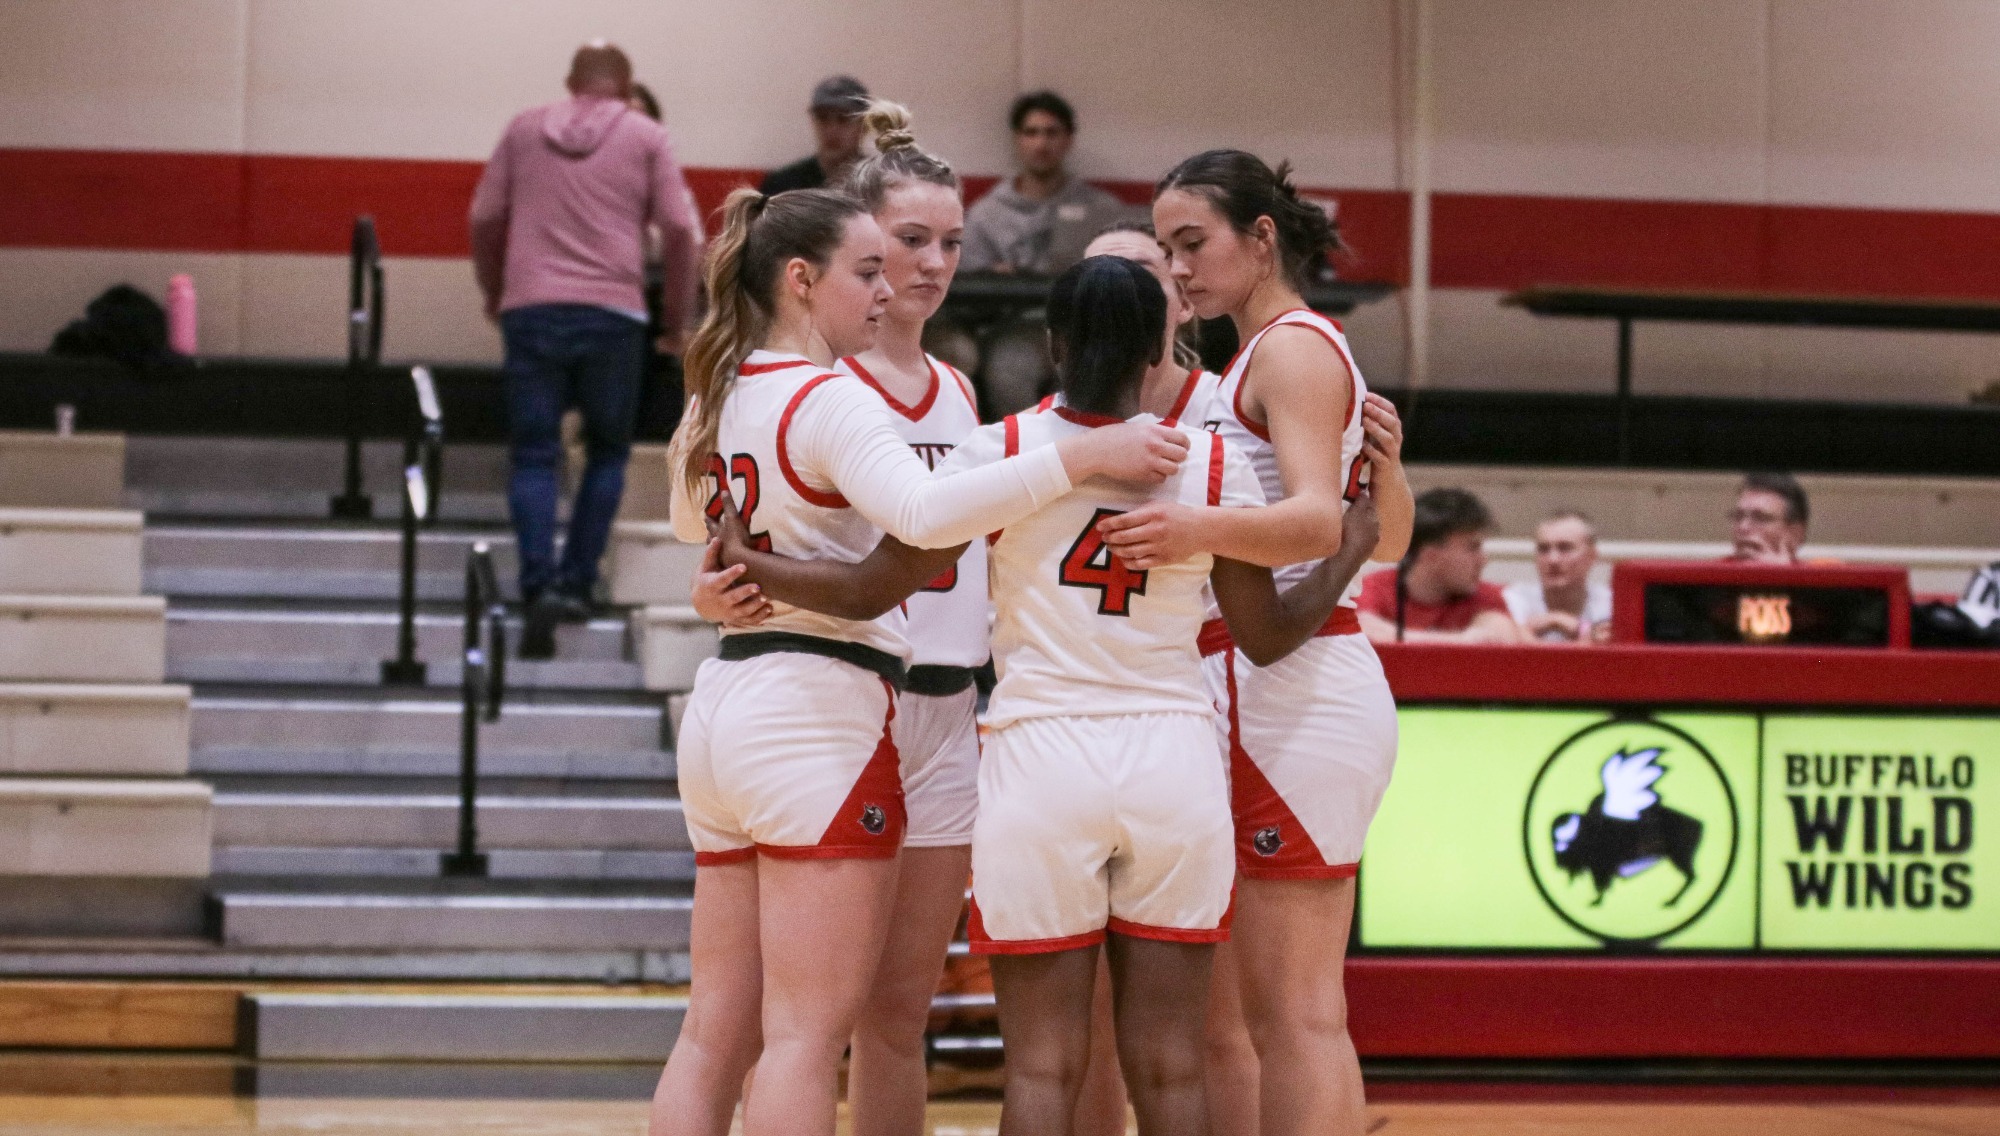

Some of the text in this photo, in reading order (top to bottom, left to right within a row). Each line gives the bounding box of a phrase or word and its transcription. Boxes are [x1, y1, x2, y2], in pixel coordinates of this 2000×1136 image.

[1058, 507, 1149, 617] 4
[1738, 597, 1792, 635] POSS
[1785, 754, 1974, 789] BUFFALO
[1786, 795, 1974, 854] WILD
[1785, 861, 1974, 910] WINGS
